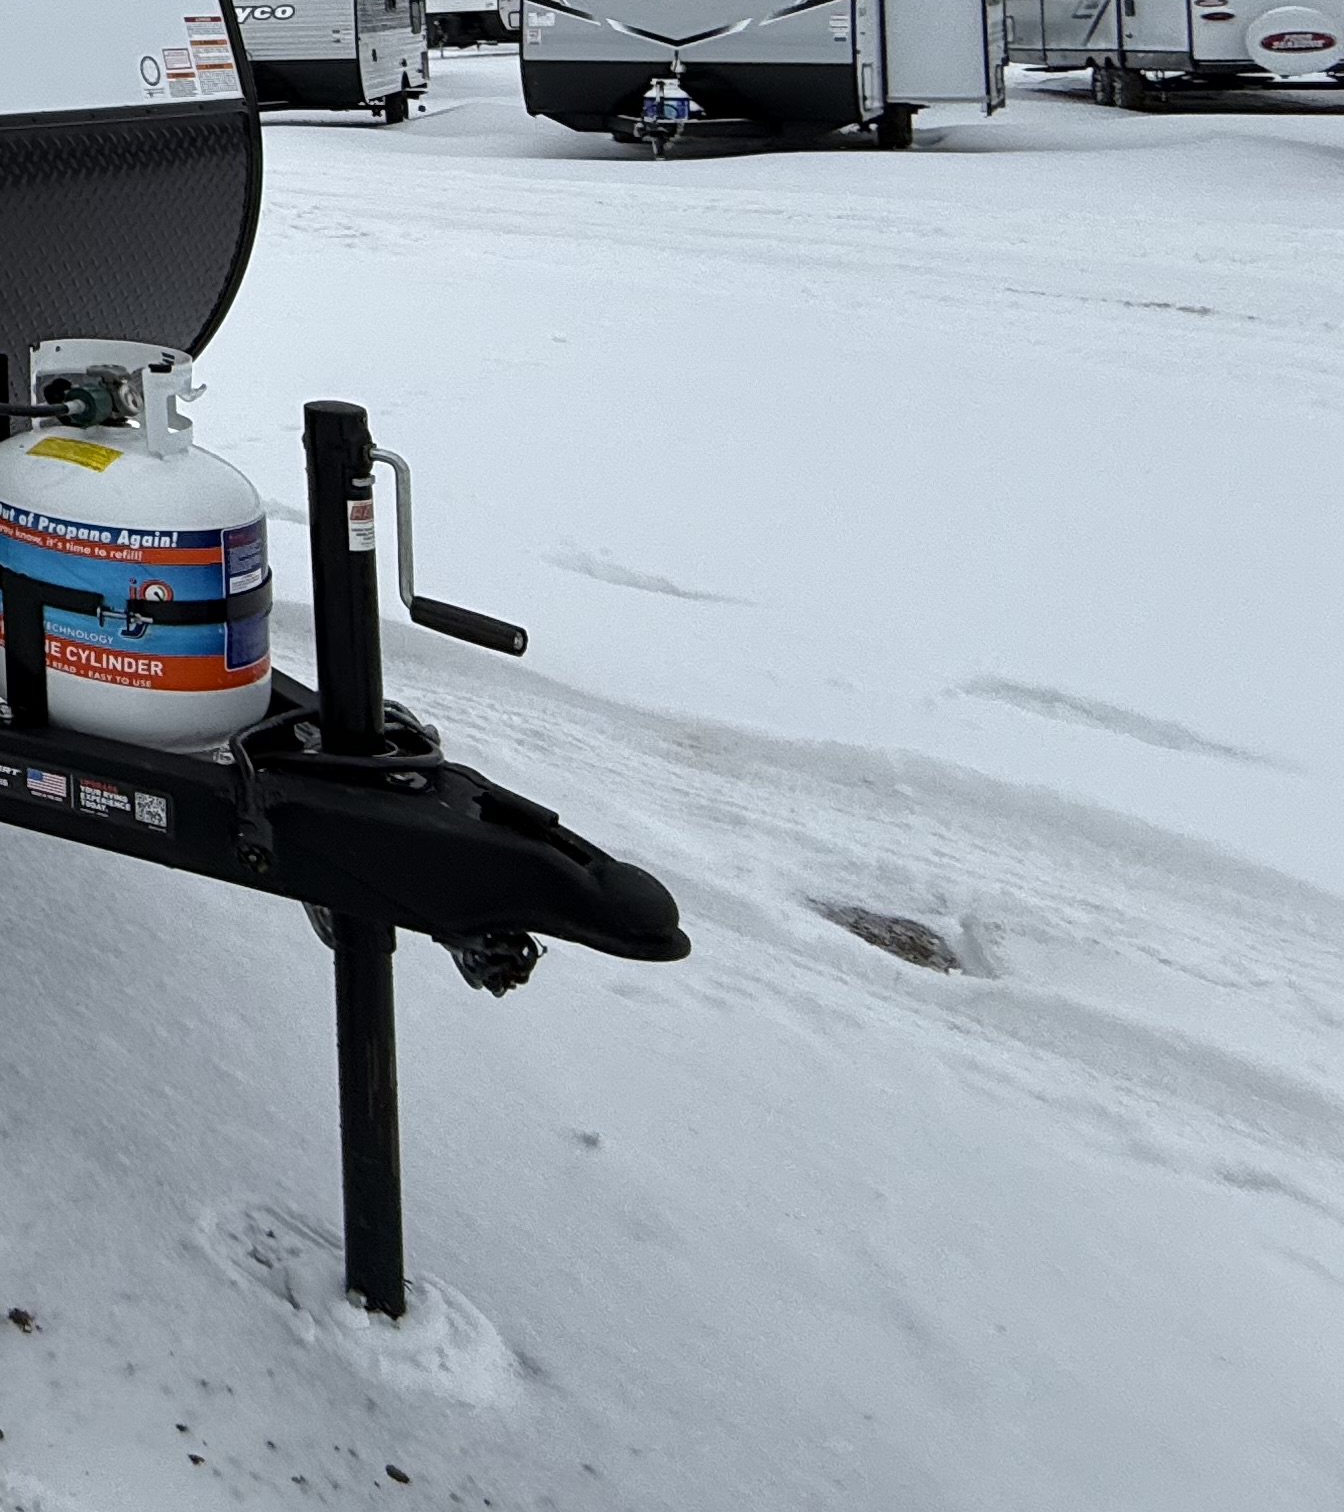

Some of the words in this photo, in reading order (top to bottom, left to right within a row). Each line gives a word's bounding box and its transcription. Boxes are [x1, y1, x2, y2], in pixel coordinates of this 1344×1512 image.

[235, 5, 295, 25] yco
[19, 513, 35, 527] of
[38, 516, 112, 544] Propane
[117, 530, 179, 549] Again!
[47, 537, 63, 550] it's
[66, 543, 91, 555] time
[95, 547, 107, 557] to
[110, 549, 143, 561] refill!
[43, 620, 113, 645] ECHNOLOGY
[66, 646, 163, 677] CYLINDER
[88, 670, 115, 682] EASY
[116, 676, 130, 685] TO
[132, 679, 152, 689] USE
